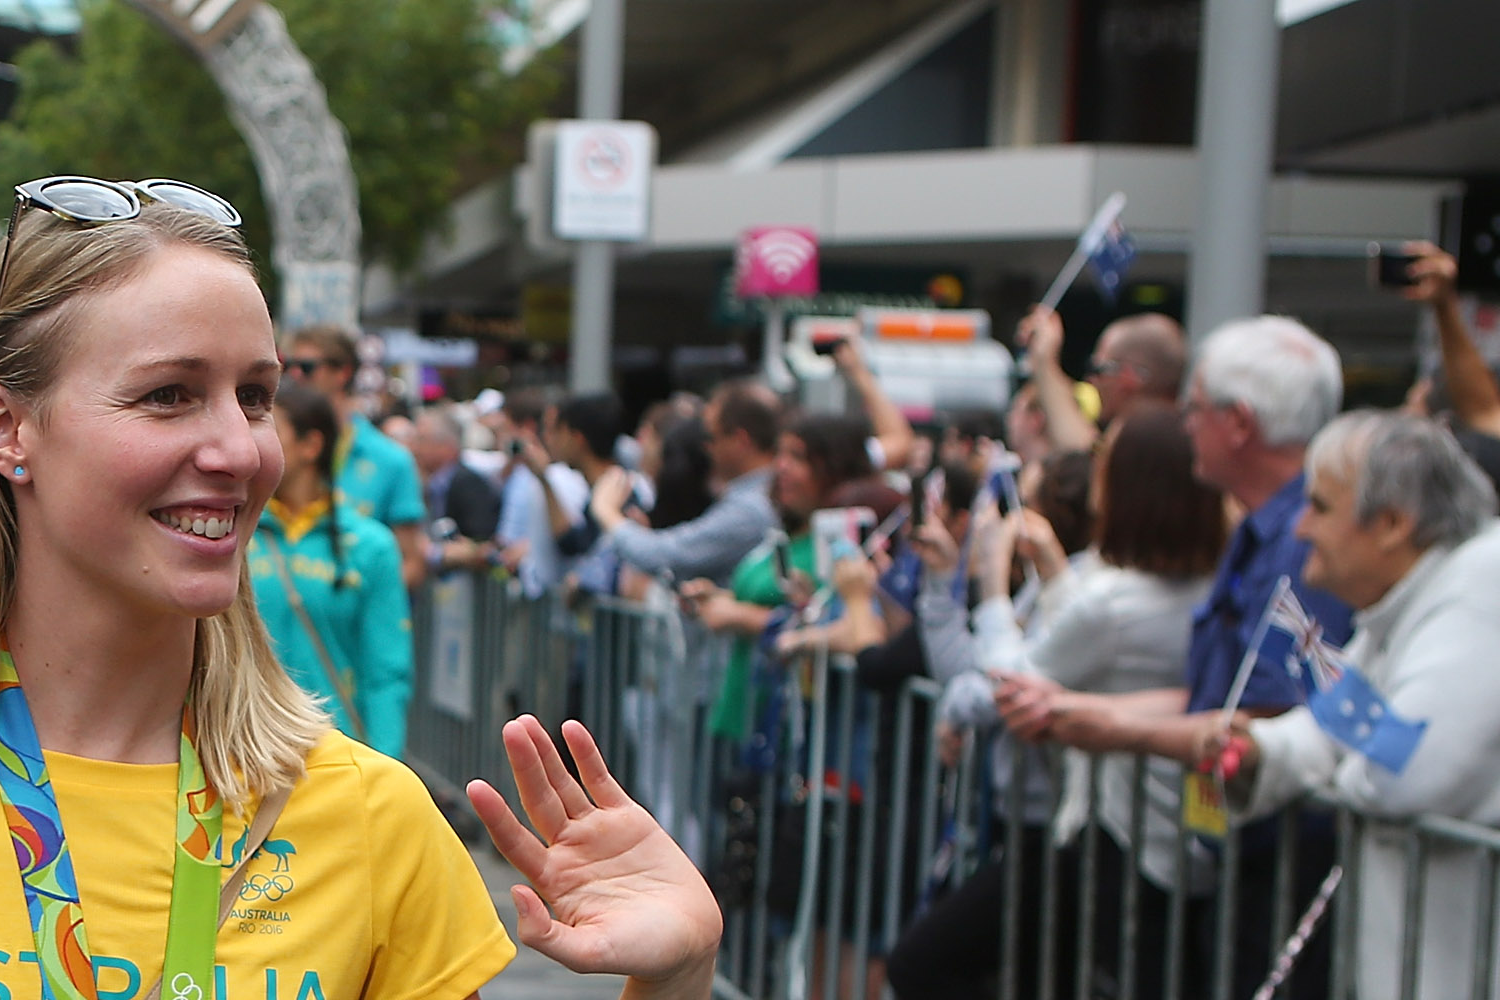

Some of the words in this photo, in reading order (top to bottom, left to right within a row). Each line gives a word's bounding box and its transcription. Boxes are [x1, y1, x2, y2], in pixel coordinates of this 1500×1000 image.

[230, 908, 291, 922] AUSTRALIA
[238, 921, 256, 934] RIO
[259, 923, 283, 935] 2016
